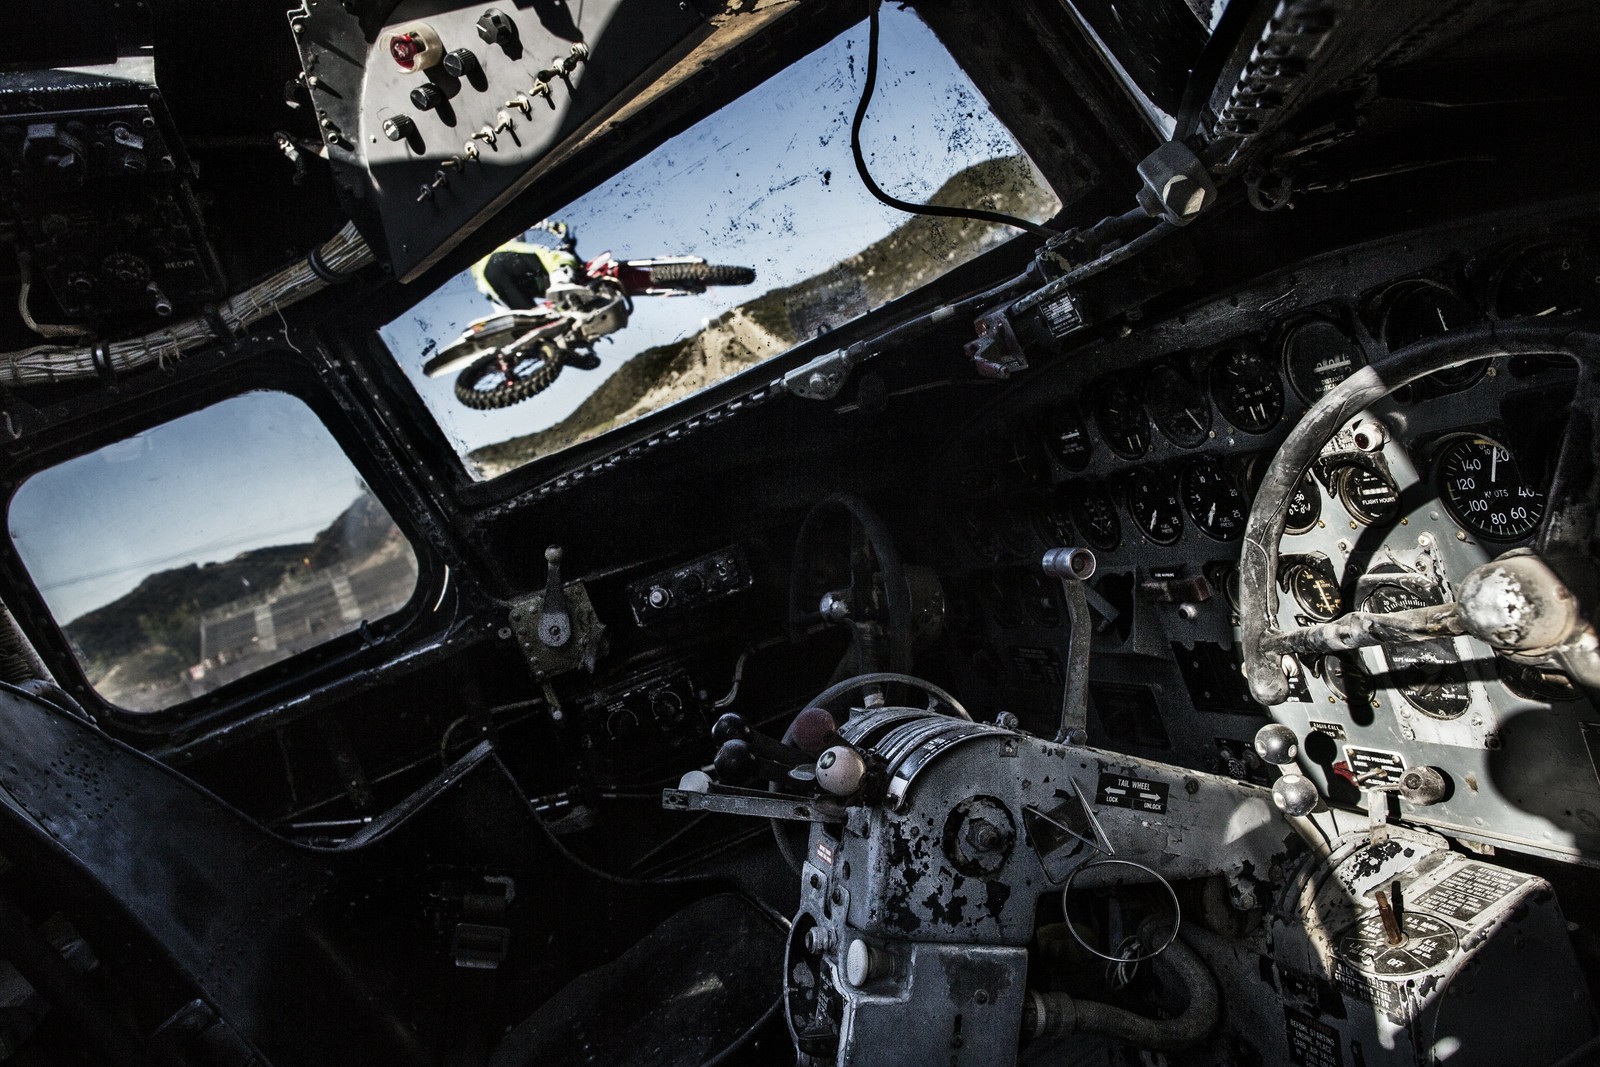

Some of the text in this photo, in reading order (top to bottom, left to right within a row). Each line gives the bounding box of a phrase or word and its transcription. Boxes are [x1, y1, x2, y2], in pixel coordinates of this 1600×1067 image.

[1462, 459, 1481, 472] 140
[1457, 478, 1475, 490] 120
[1229, 488, 1238, 497] 20
[1469, 499, 1488, 512] 100
[1232, 509, 1241, 518] 25
[1491, 513, 1507, 525] 80
[1511, 507, 1526, 520] 60
[822, 754, 833, 766] M
[1118, 778, 1151, 791] TAIL WHEEL
[1106, 796, 1119, 804] LOCK
[1144, 801, 1162, 811] UNLOCK
[1477, 867, 1513, 879] ATTENTION
[1421, 921, 1440, 931] MAIN
[1362, 947, 1378, 956] AUX
[1418, 944, 1433, 953] AUX
[1387, 958, 1406, 968] OFF
[1335, 973, 1355, 985] CENTER
[1376, 991, 1391, 1002] FUEL
[1290, 1019, 1309, 1034] BEFORE
[1309, 1029, 1335, 1046] STARTING
[1296, 1030, 1332, 1054] ENGINE PLACE
[1320, 1051, 1336, 1066] VALVE
